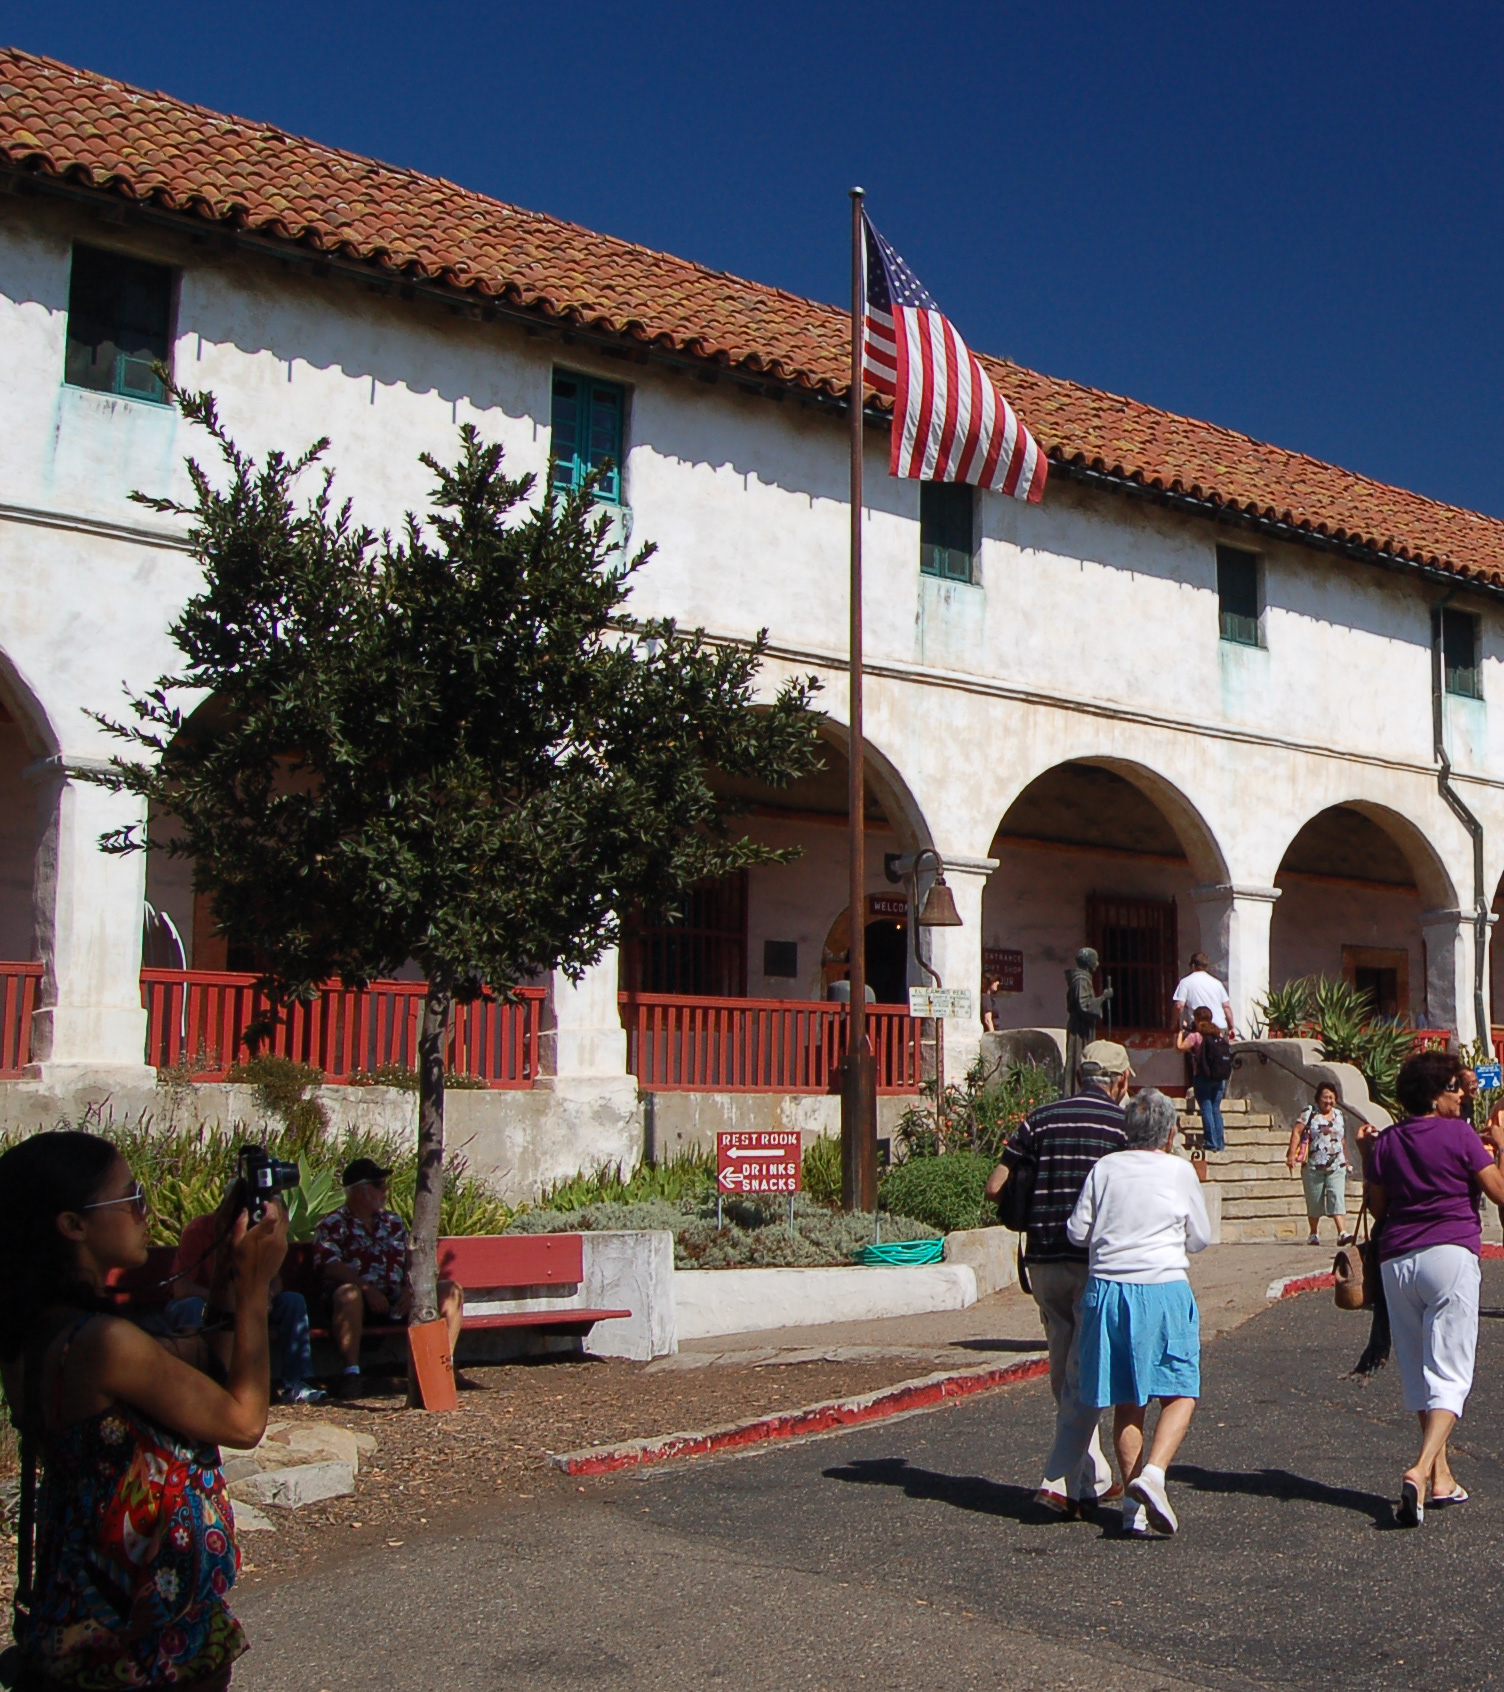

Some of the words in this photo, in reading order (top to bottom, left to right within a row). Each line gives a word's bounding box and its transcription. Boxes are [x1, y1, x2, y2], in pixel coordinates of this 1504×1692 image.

[874, 901, 908, 913] WELCO
[742, 1163, 796, 1176] DRINKS
[742, 1178, 796, 1191] SNACKS
